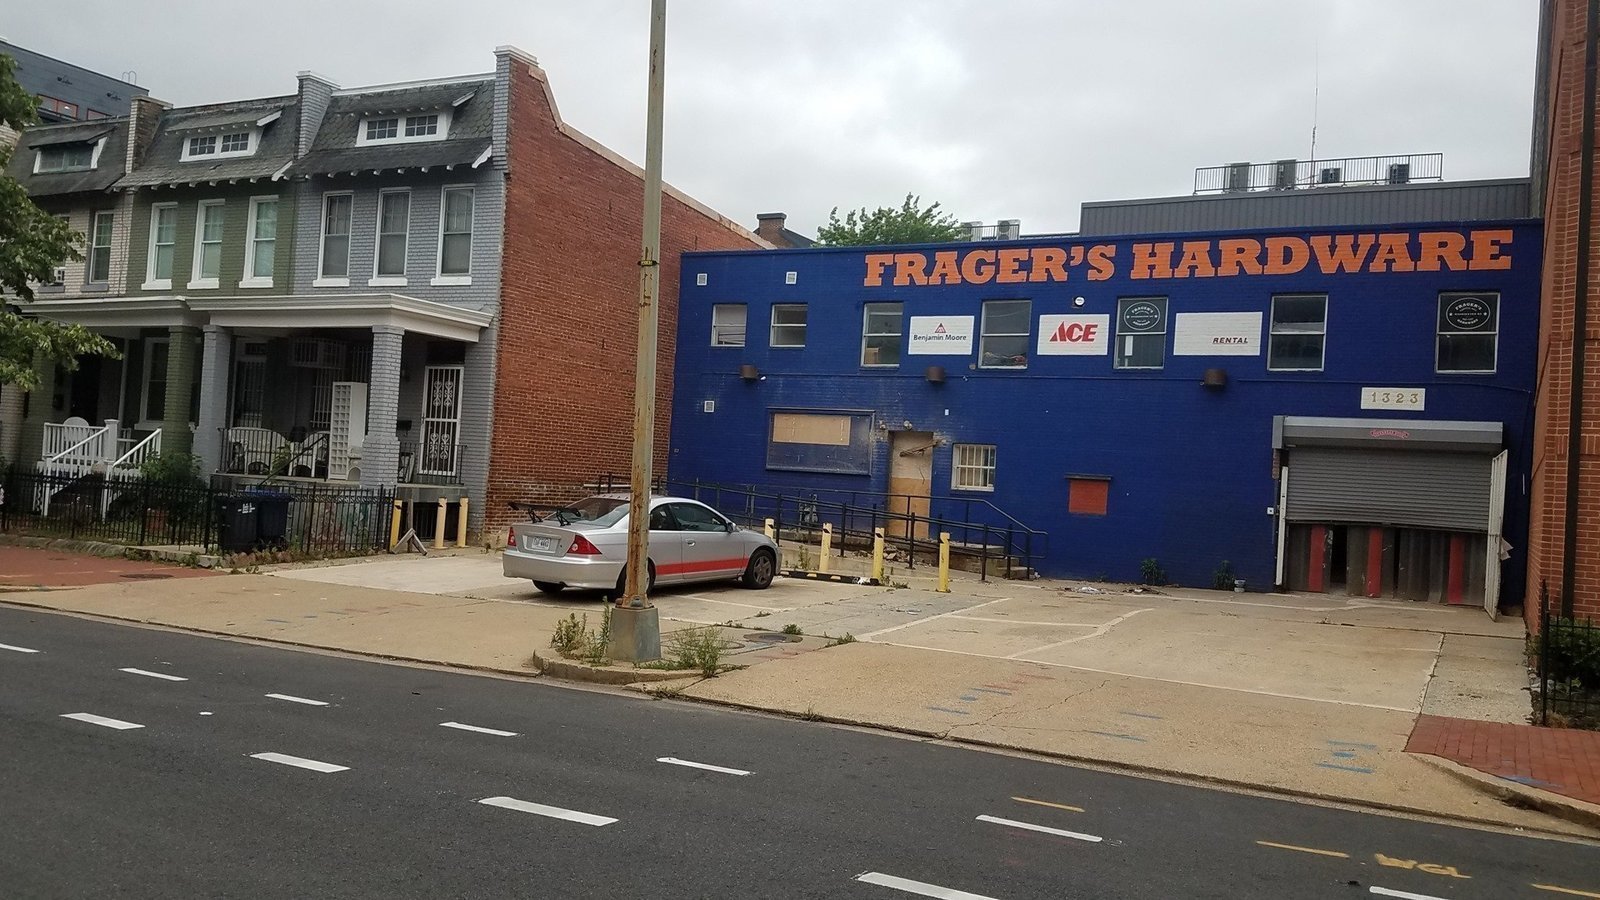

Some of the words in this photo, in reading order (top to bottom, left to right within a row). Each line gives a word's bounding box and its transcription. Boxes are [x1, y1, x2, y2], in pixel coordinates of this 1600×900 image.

[863, 244, 1117, 287] FRAGER'S
[1130, 230, 1513, 279] HARDWARE
[1049, 321, 1098, 342] ACE
[913, 334, 944, 343] Benjamin
[1212, 337, 1249, 345] RENTAL
[1371, 391, 1419, 404] 1323
